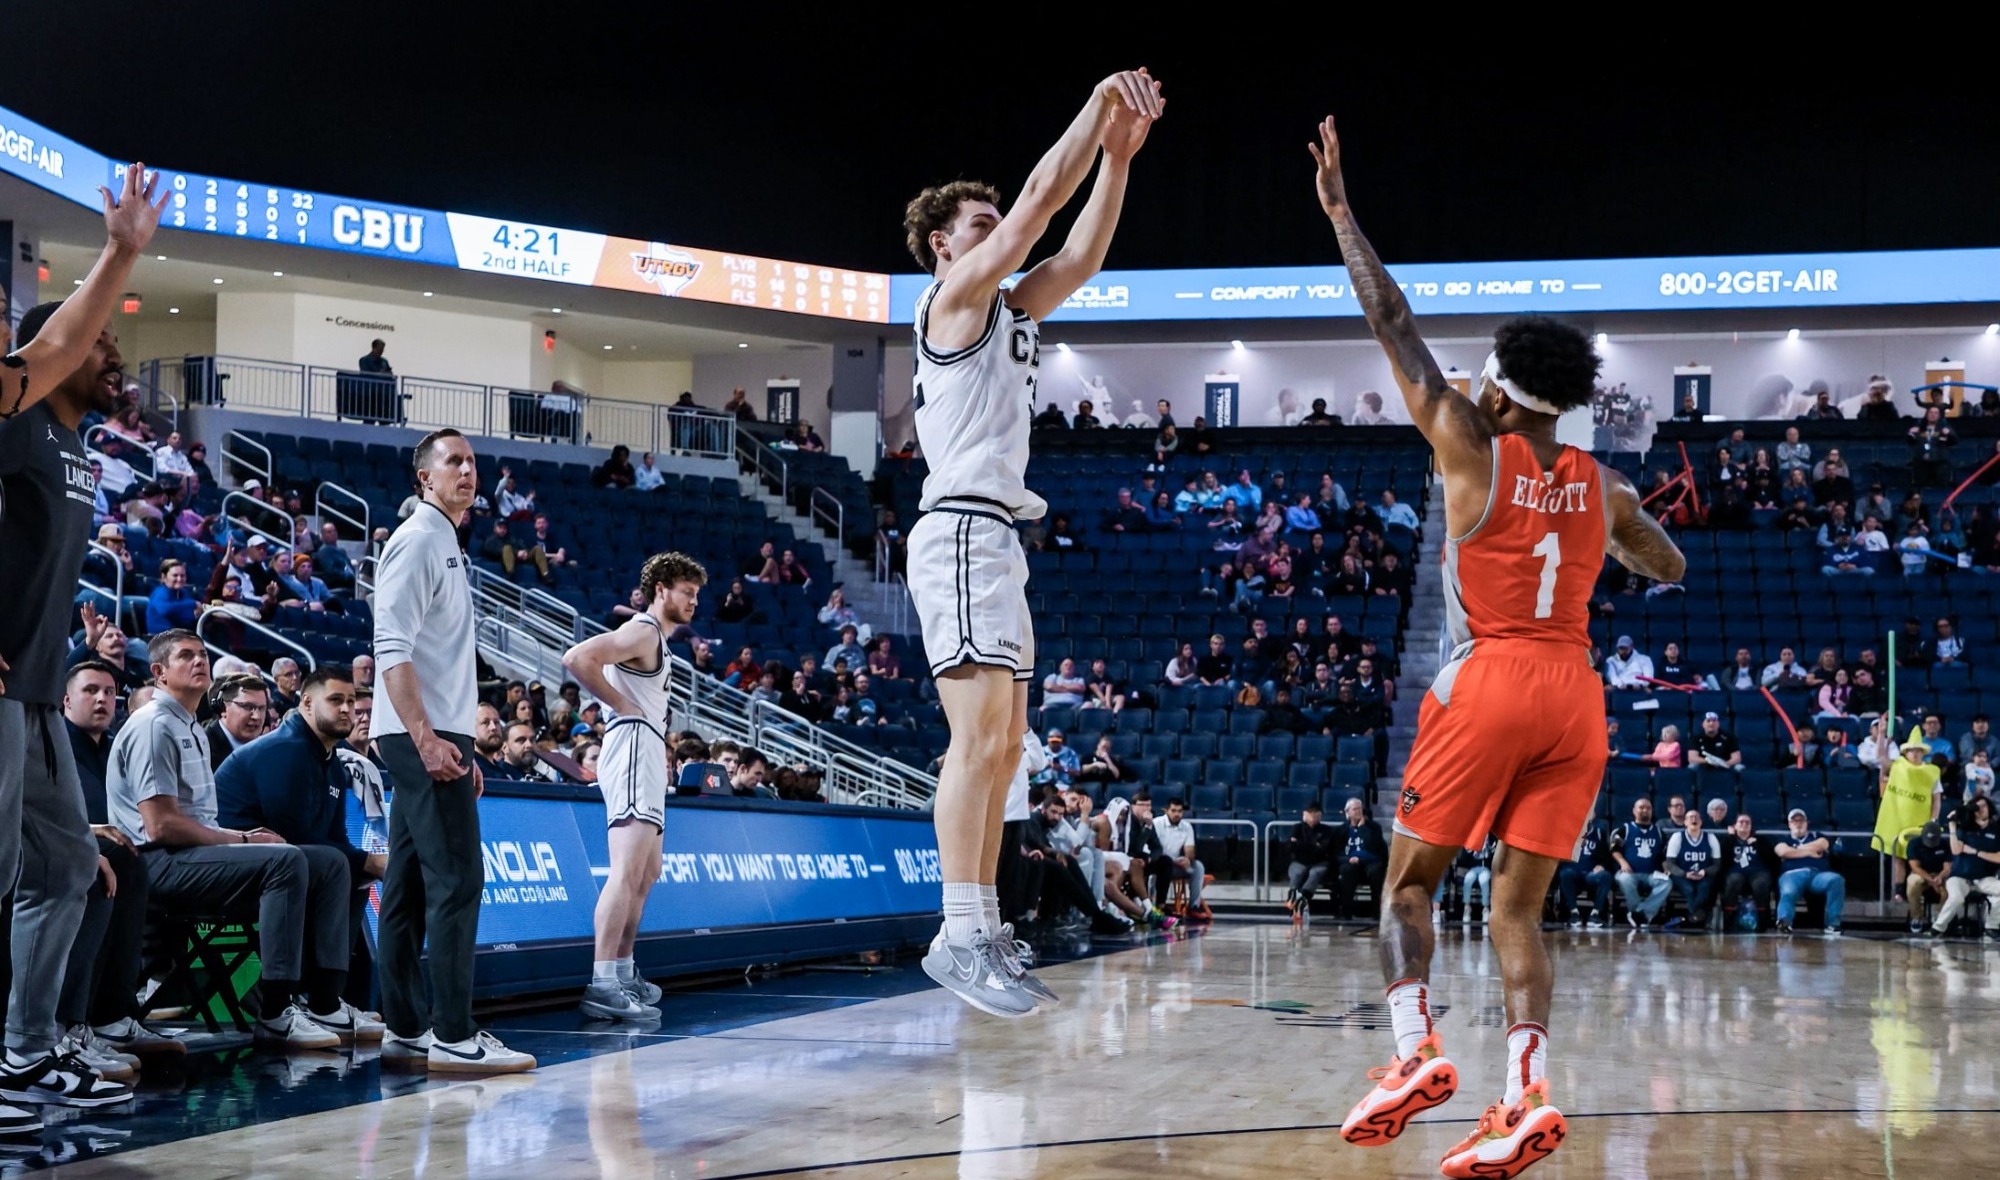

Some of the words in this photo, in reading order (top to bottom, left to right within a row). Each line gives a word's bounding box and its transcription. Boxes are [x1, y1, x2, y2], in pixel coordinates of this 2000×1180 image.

[173, 174, 188, 191] 0
[205, 179, 218, 196] 2
[236, 184, 249, 200] 4
[267, 188, 279, 204] 5
[292, 192, 314, 210] 32
[173, 192, 187, 209] 9
[204, 197, 217, 214] 8
[236, 201, 248, 218] 5
[266, 206, 279, 222] 0
[296, 211, 308, 227] 0
[173, 210, 186, 227] 3
[205, 215, 217, 231] 2
[235, 219, 248, 236] 3
[266, 223, 278, 240] 2
[297, 228, 307, 244] 1
[332, 204, 425, 254] CBU
[493, 224, 559, 256] 4:21
[482, 251, 516, 271] 2nd
[523, 257, 571, 277] HALF
[636, 255, 700, 280] UTRGV
[722, 255, 757, 273] PLYR
[773, 262, 783, 277] 1
[730, 272, 757, 289] PTS
[796, 281, 808, 297] 0
[1211, 286, 1301, 301] COMFORT
[1306, 285, 1344, 299] YOU
[1413, 282, 1439, 297] TO
[1444, 281, 1472, 296] GO
[1476, 280, 1534, 296] HOME
[1539, 279, 1566, 294] TO
[1659, 269, 1839, 297] 800-2GET-AIR
[731, 288, 757, 305] FLS
[772, 293, 783, 309] 2
[795, 297, 807, 312] 0
[821, 301, 830, 316] 1
[845, 303, 853, 319] 1
[868, 305, 880, 321] 3
[335, 315, 395, 333] Concessions
[1532, 532, 1562, 619] 1
[480, 841, 562, 883] NOLIA
[660, 852, 700, 883] FORT
[699, 852, 734, 882] YOU
[732, 852, 776, 882] WANT
[776, 853, 798, 881] TO
[796, 853, 818, 880] GO
[815, 853, 853, 880] HOME
[850, 853, 869, 879] TO
[1684, 851, 1706, 862] CBU
[494, 887, 519, 904] AND
